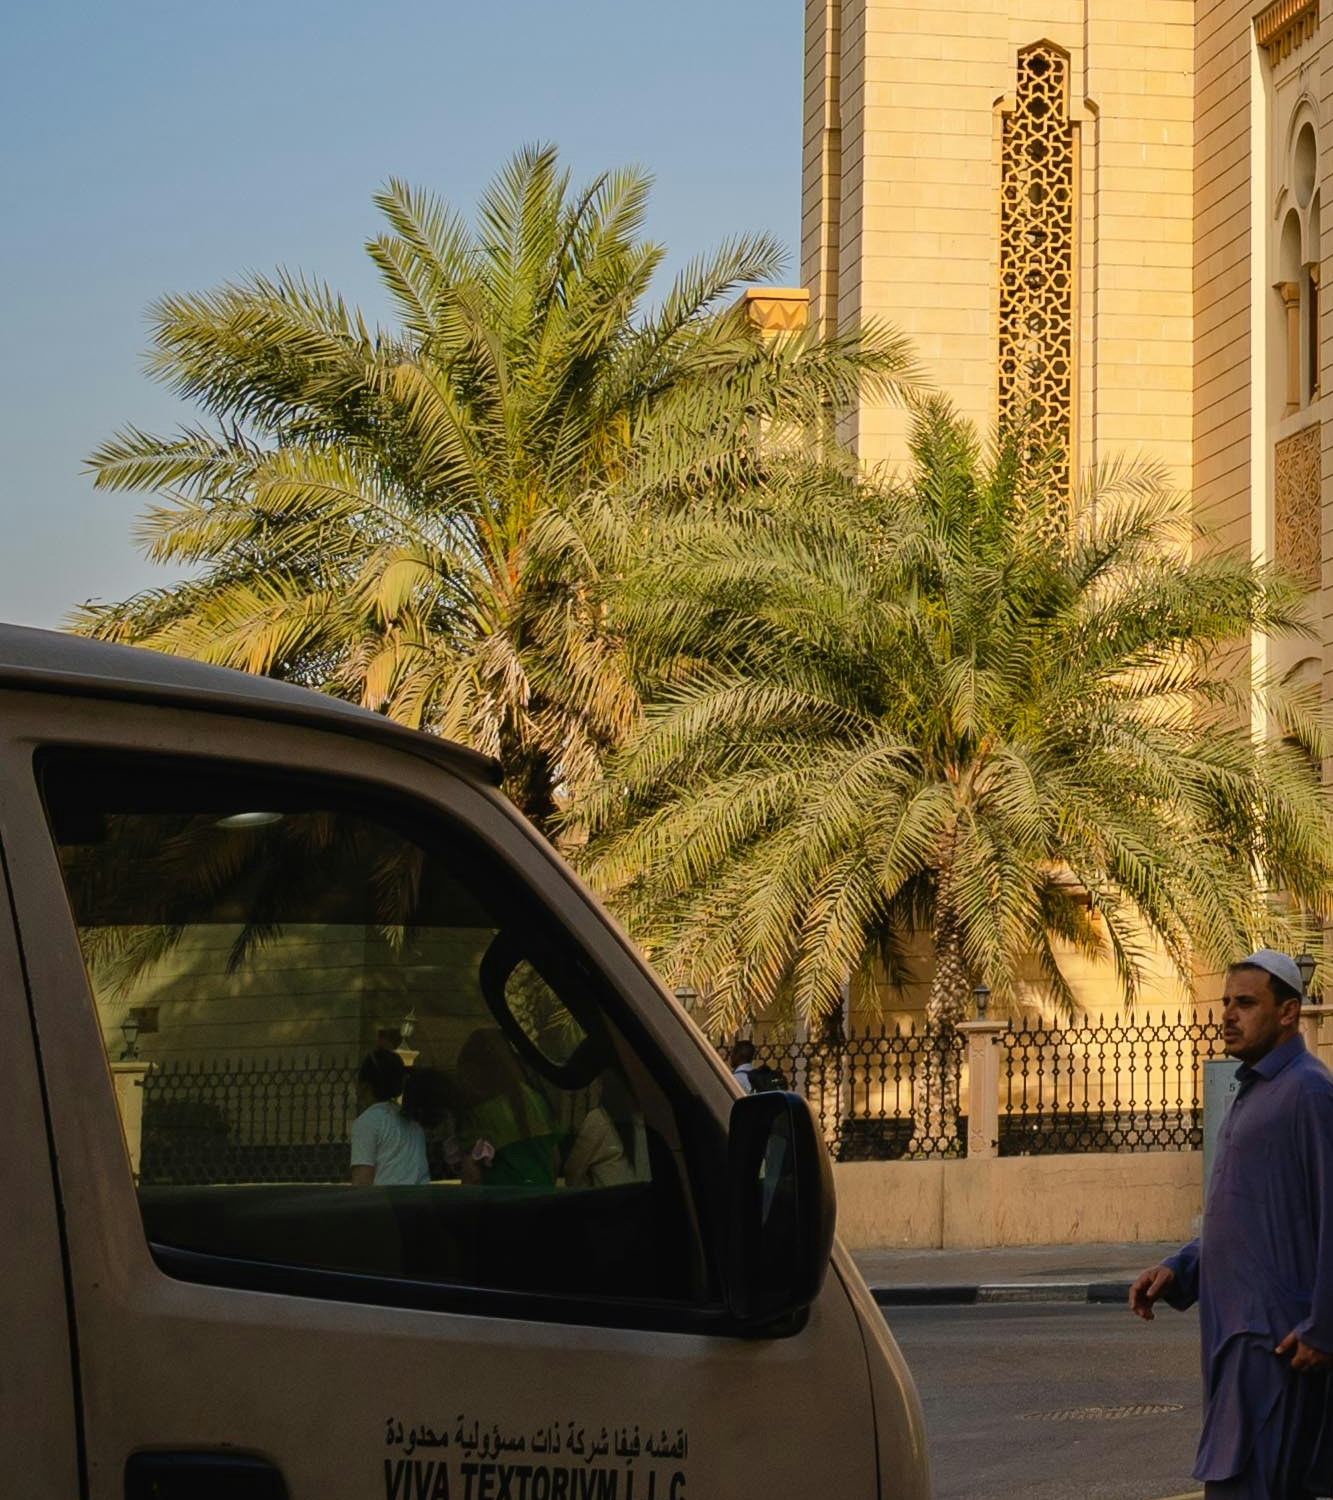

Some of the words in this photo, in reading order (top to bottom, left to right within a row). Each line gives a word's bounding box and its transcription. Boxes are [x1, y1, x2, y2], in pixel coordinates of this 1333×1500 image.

[385, 1416, 448, 1455] محدودة
[455, 1415, 525, 1459] مسؤولية
[531, 1421, 561, 1454] ذات
[567, 1420, 608, 1464] شركة
